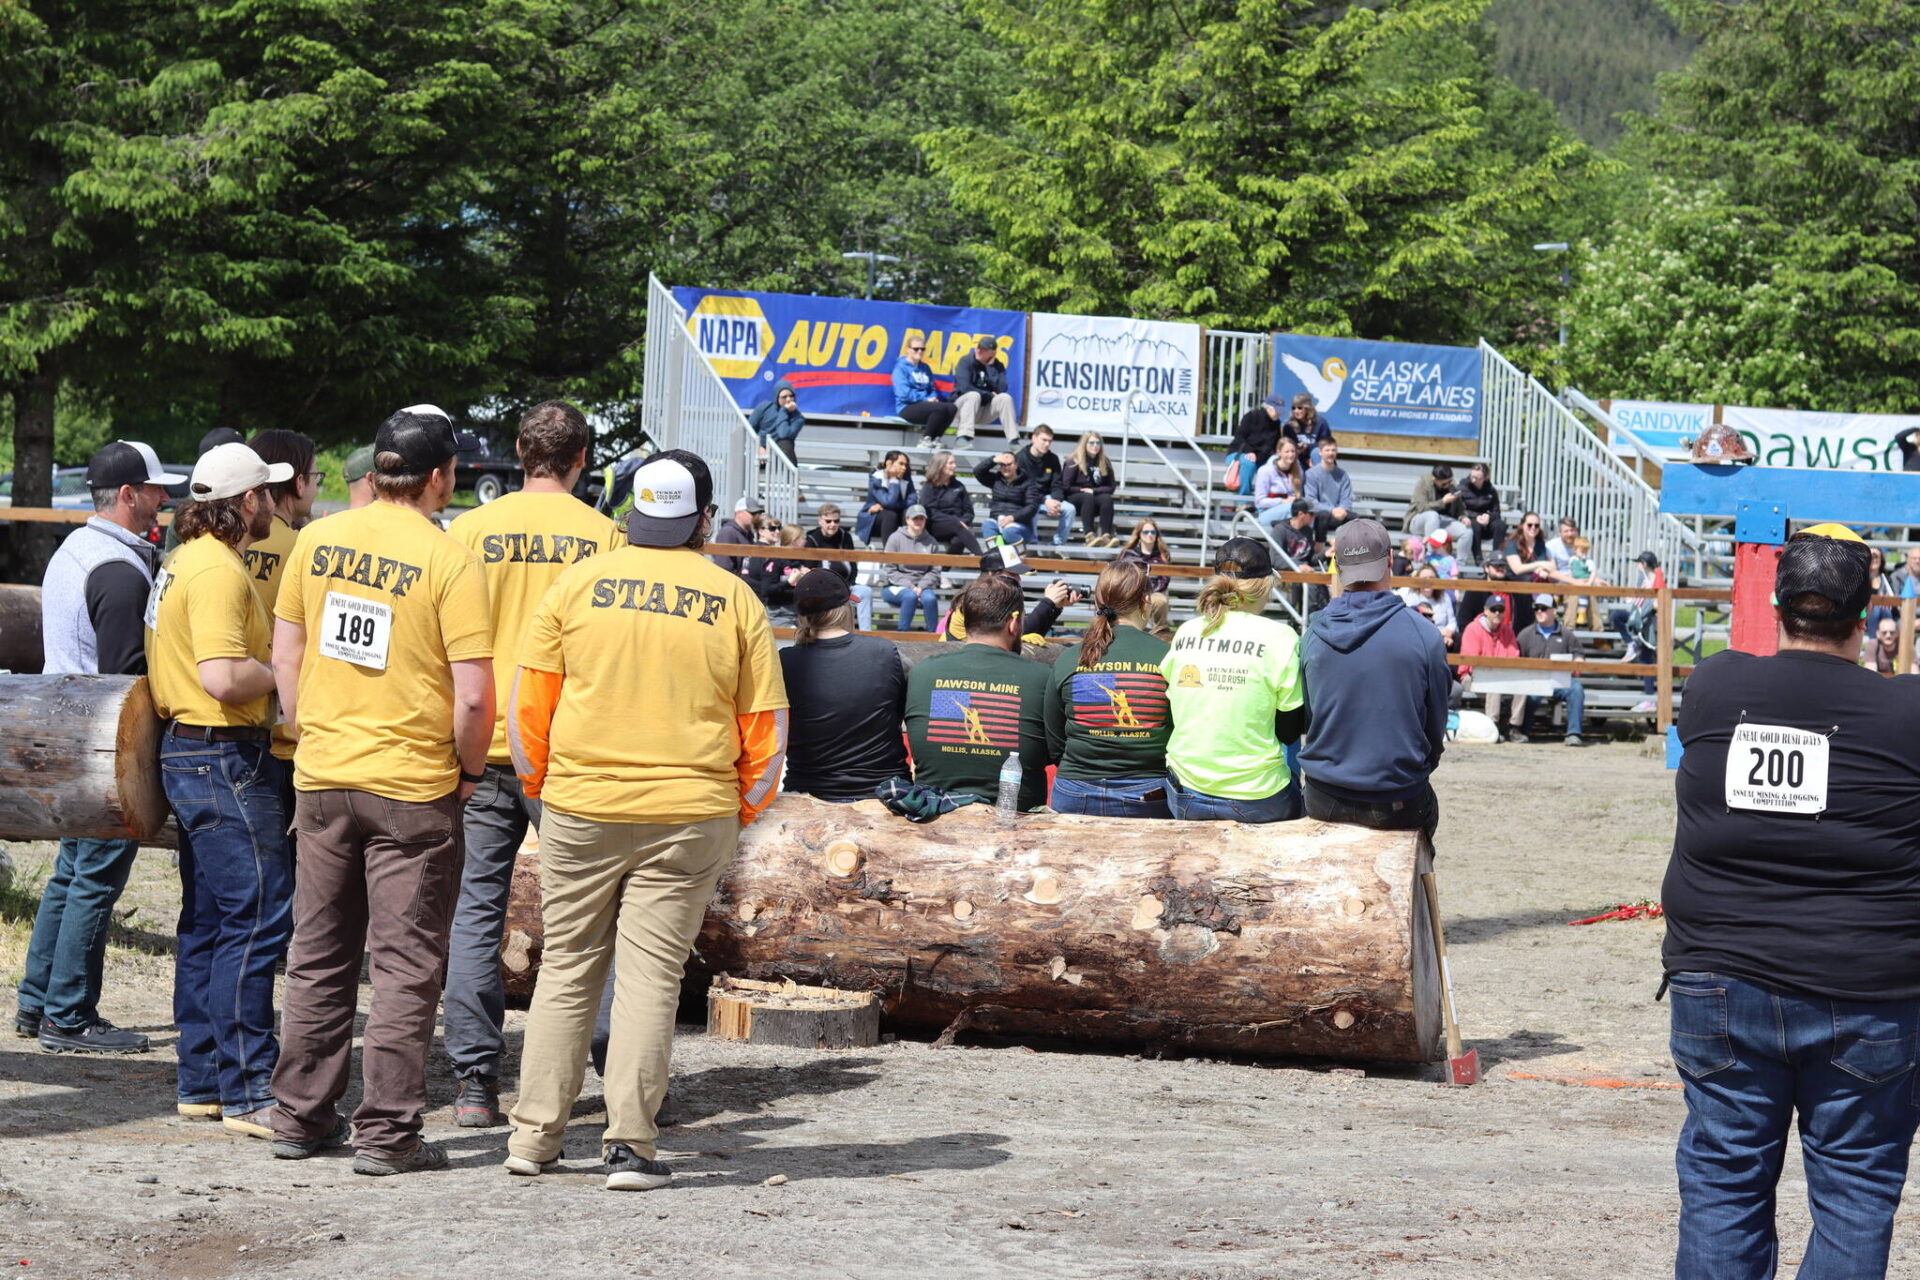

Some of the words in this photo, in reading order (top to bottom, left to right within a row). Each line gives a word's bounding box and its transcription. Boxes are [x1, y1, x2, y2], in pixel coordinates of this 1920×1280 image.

[700, 317, 758, 356] NAPA
[776, 320, 888, 370] AUTO
[1036, 359, 1174, 394] KENSINGTON
[1178, 368, 1191, 396] MINE
[1351, 358, 1442, 384] ALASKA
[1066, 395, 1121, 412] COEUR
[1127, 400, 1188, 416] ALASKA
[1350, 379, 1476, 409] SEAPLANES
[1349, 407, 1379, 417] FLYING
[1379, 409, 1391, 417] AT
[1429, 412, 1473, 422] STANDARD
[1617, 409, 1704, 431] SANDVIK
[482, 533, 598, 564] STAFF
[310, 545, 423, 597] STAFF
[591, 578, 727, 626] STAFF
[335, 612, 375, 647] 189
[1175, 636, 1267, 658] WHITMORE
[1136, 662, 1160, 673] MIN
[1208, 673, 1227, 683] GOLD
[1227, 674, 1246, 684] RUSH
[935, 678, 986, 691] DAWSON
[989, 682, 1020, 695] MINE
[1217, 684, 1233, 692] days
[1760, 731, 1780, 744] GOLD
[1781, 732, 1801, 745] RUSH
[970, 747, 1002, 756] ALASKA
[1748, 747, 1805, 788] 200
